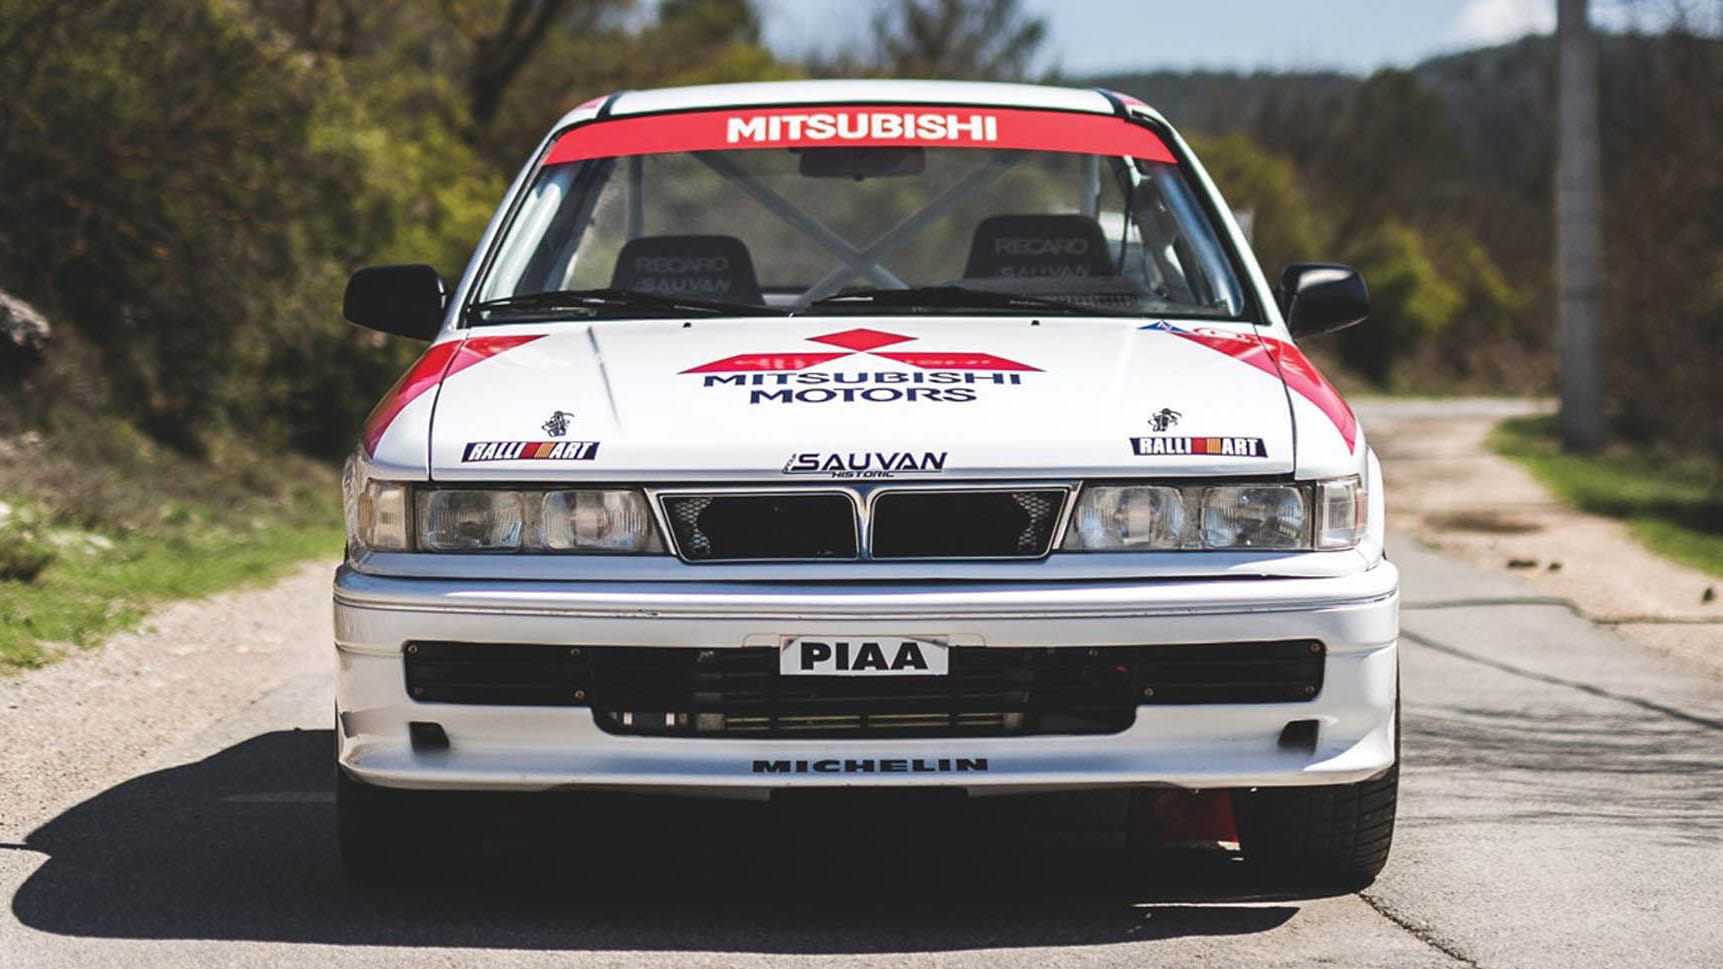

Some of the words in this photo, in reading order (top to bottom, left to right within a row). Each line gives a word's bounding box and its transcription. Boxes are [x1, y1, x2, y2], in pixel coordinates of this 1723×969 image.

[727, 113, 998, 143] MITSUBISHI
[995, 238, 1088, 255] RECARO
[635, 256, 729, 273] RECARO
[703, 371, 1022, 387] MITSUBISHI
[750, 387, 977, 404] MOTORS
[791, 451, 948, 471] SAUVAN
[832, 470, 894, 479] HISTORIC
[800, 642, 929, 671] PIAA
[752, 758, 989, 773] MICHELIN
